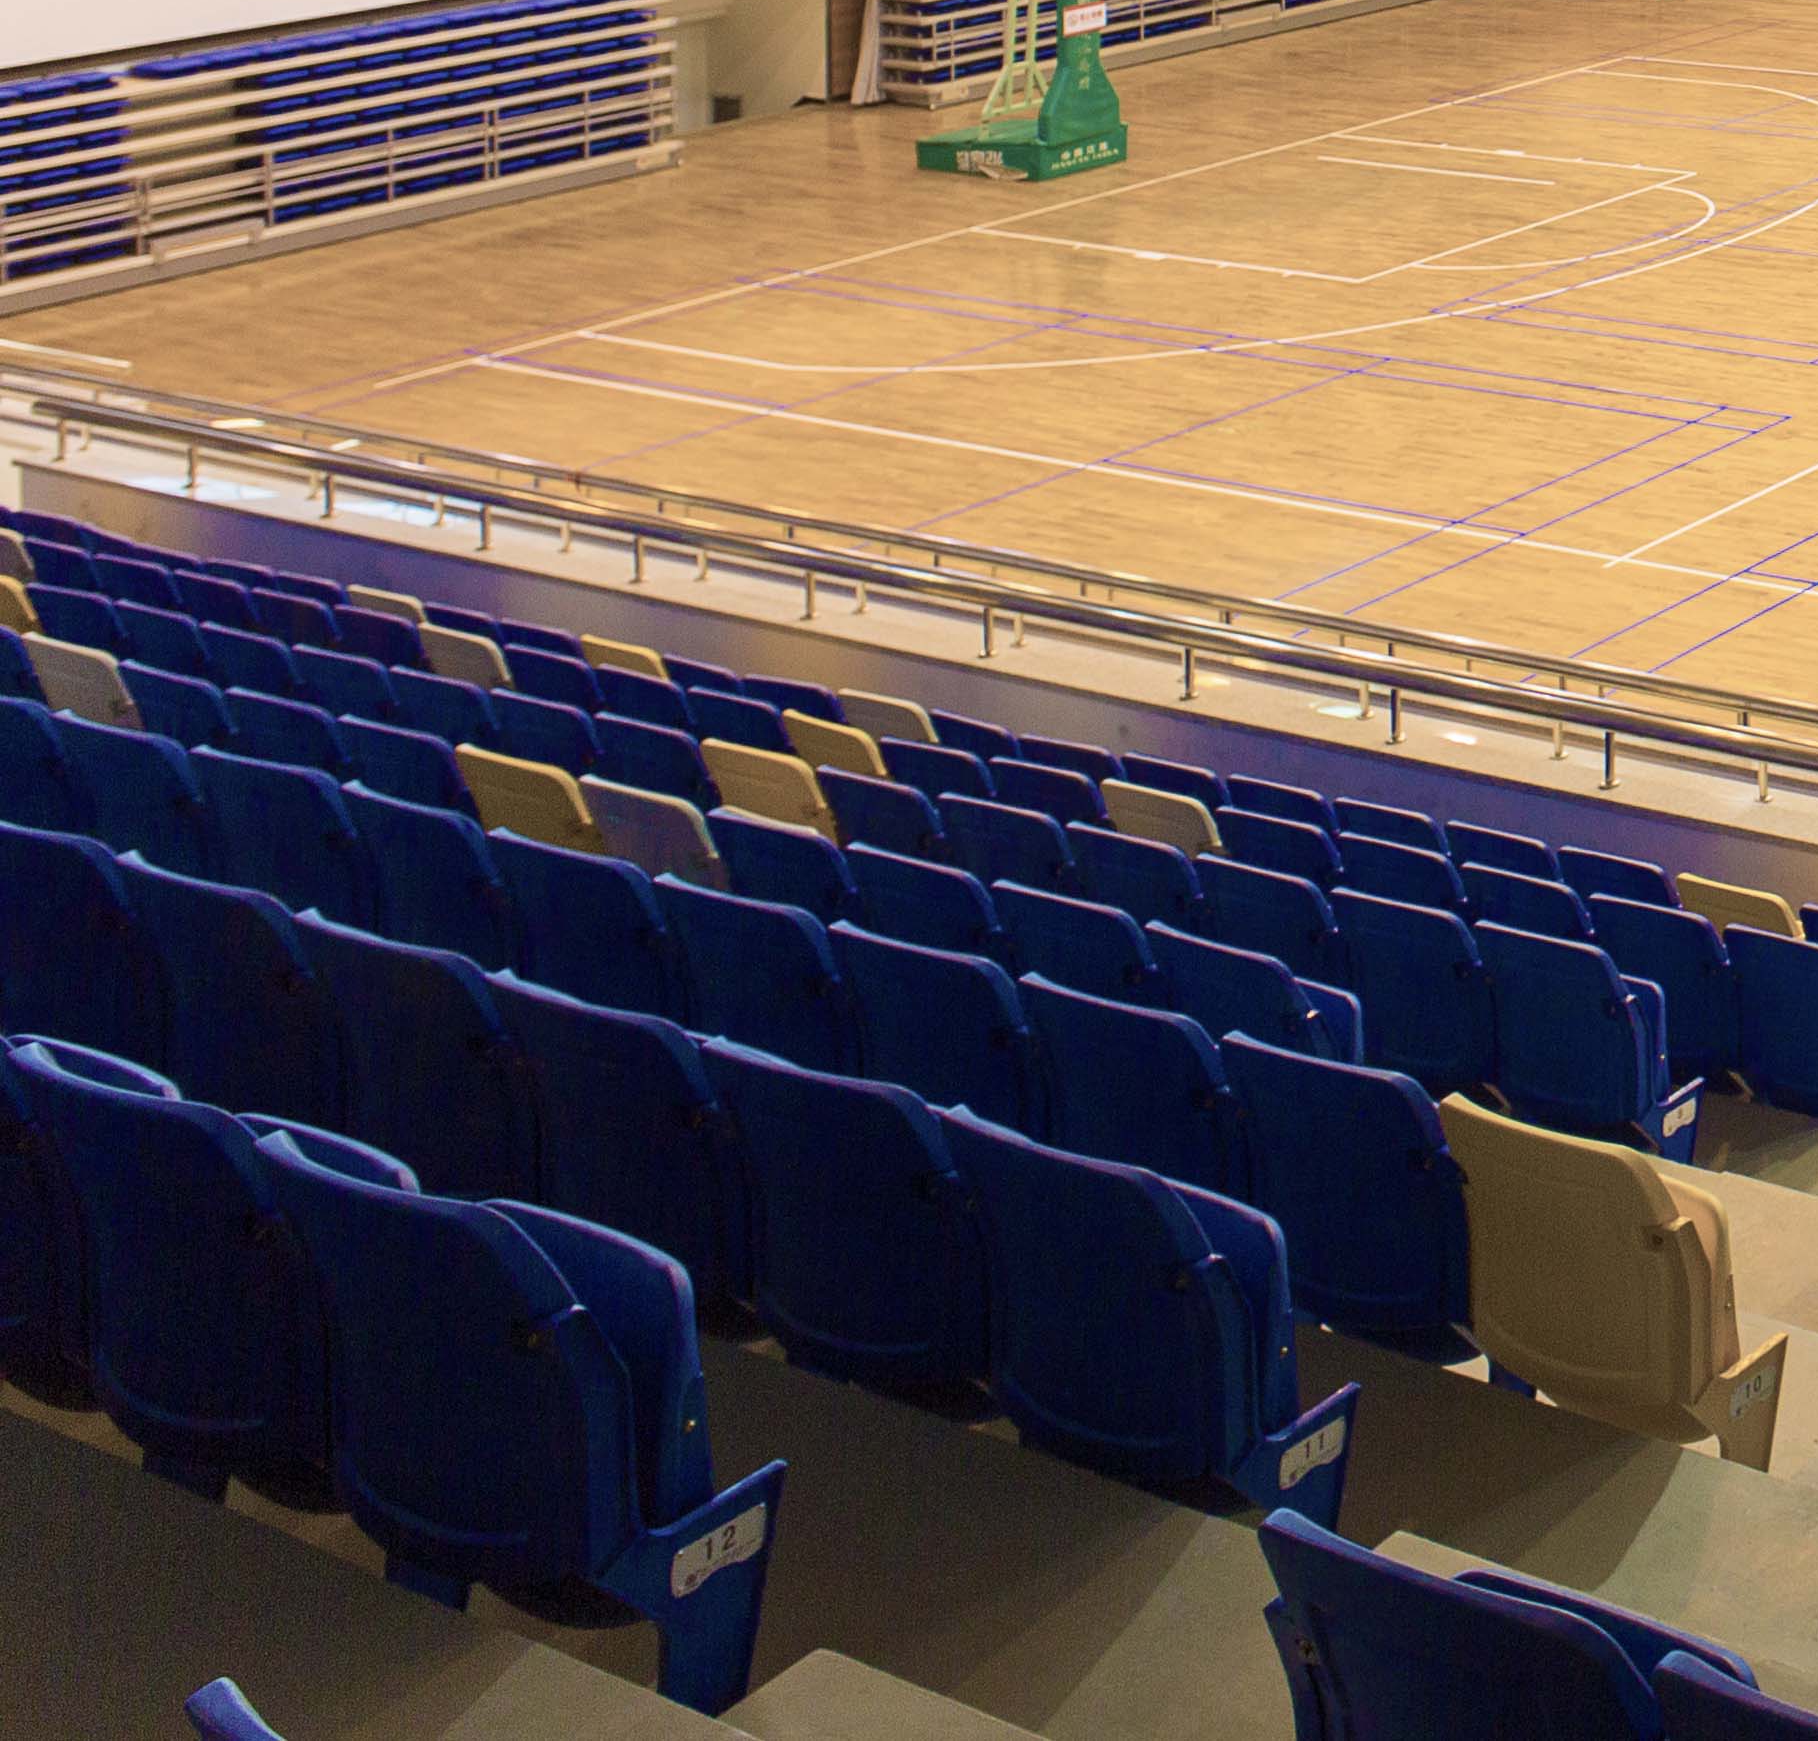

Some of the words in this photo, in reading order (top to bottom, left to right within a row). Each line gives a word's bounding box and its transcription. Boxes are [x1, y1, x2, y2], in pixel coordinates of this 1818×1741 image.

[1745, 1375, 1761, 1398] 10
[1304, 1432, 1325, 1458] 11
[706, 1524, 736, 1560] 12
